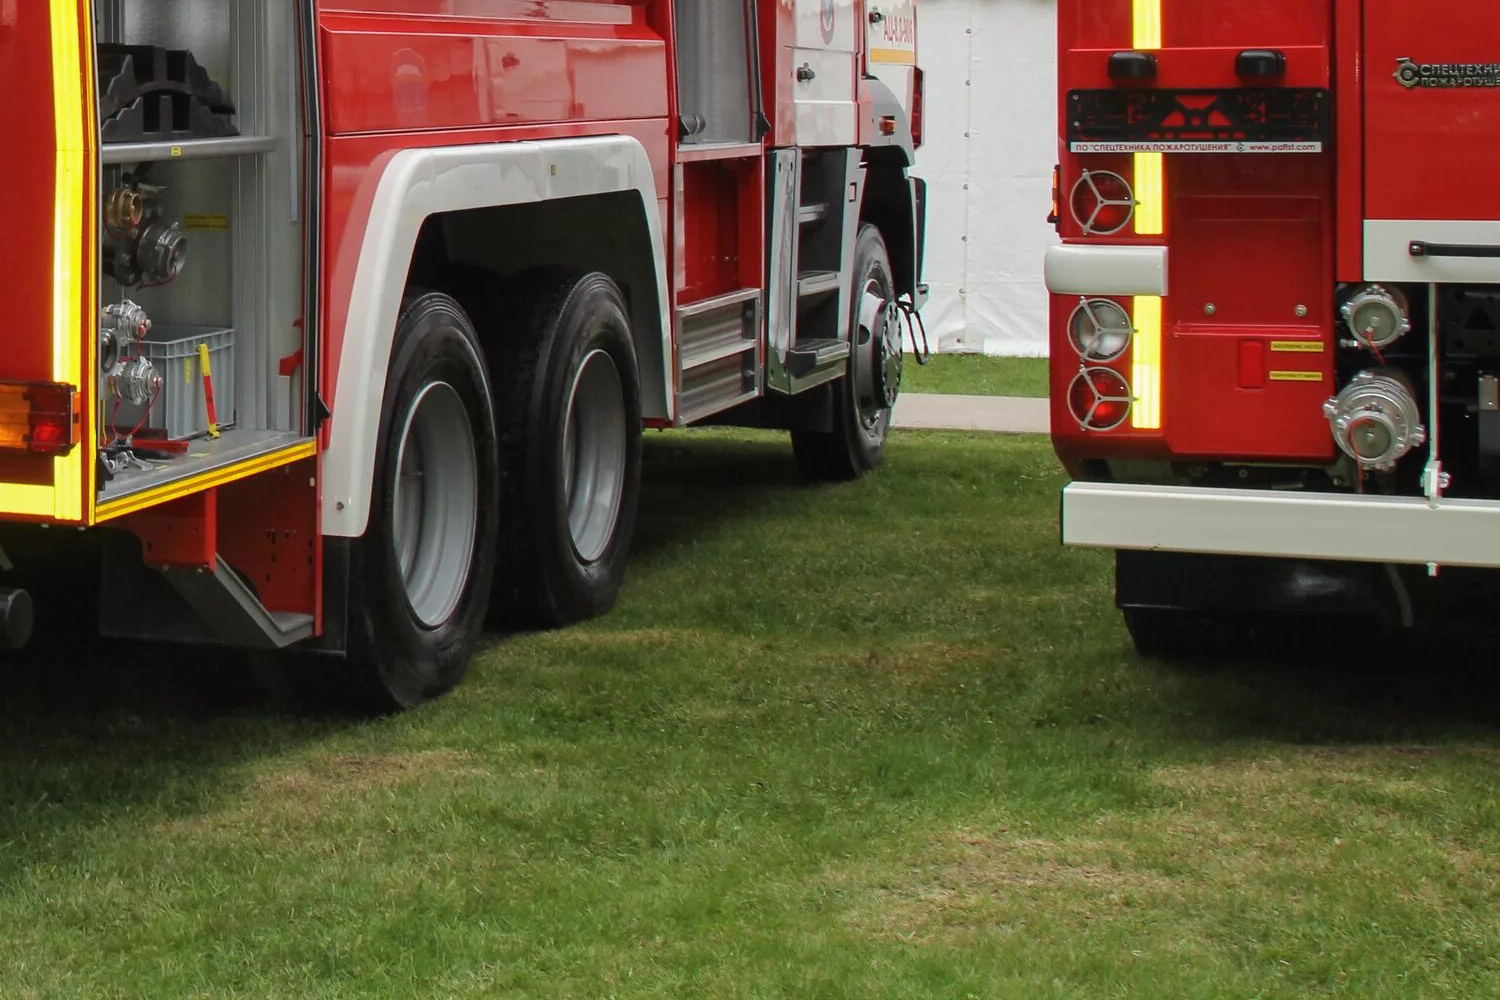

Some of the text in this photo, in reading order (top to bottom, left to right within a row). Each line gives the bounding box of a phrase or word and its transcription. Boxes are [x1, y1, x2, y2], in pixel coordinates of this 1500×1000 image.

[1075, 144, 1088, 152] ПО
[1091, 143, 1151, 152] "СПЕЦТЕХНИКА
[1154, 143, 1232, 152] ПОЖАРОТУШЕНИЯ"
